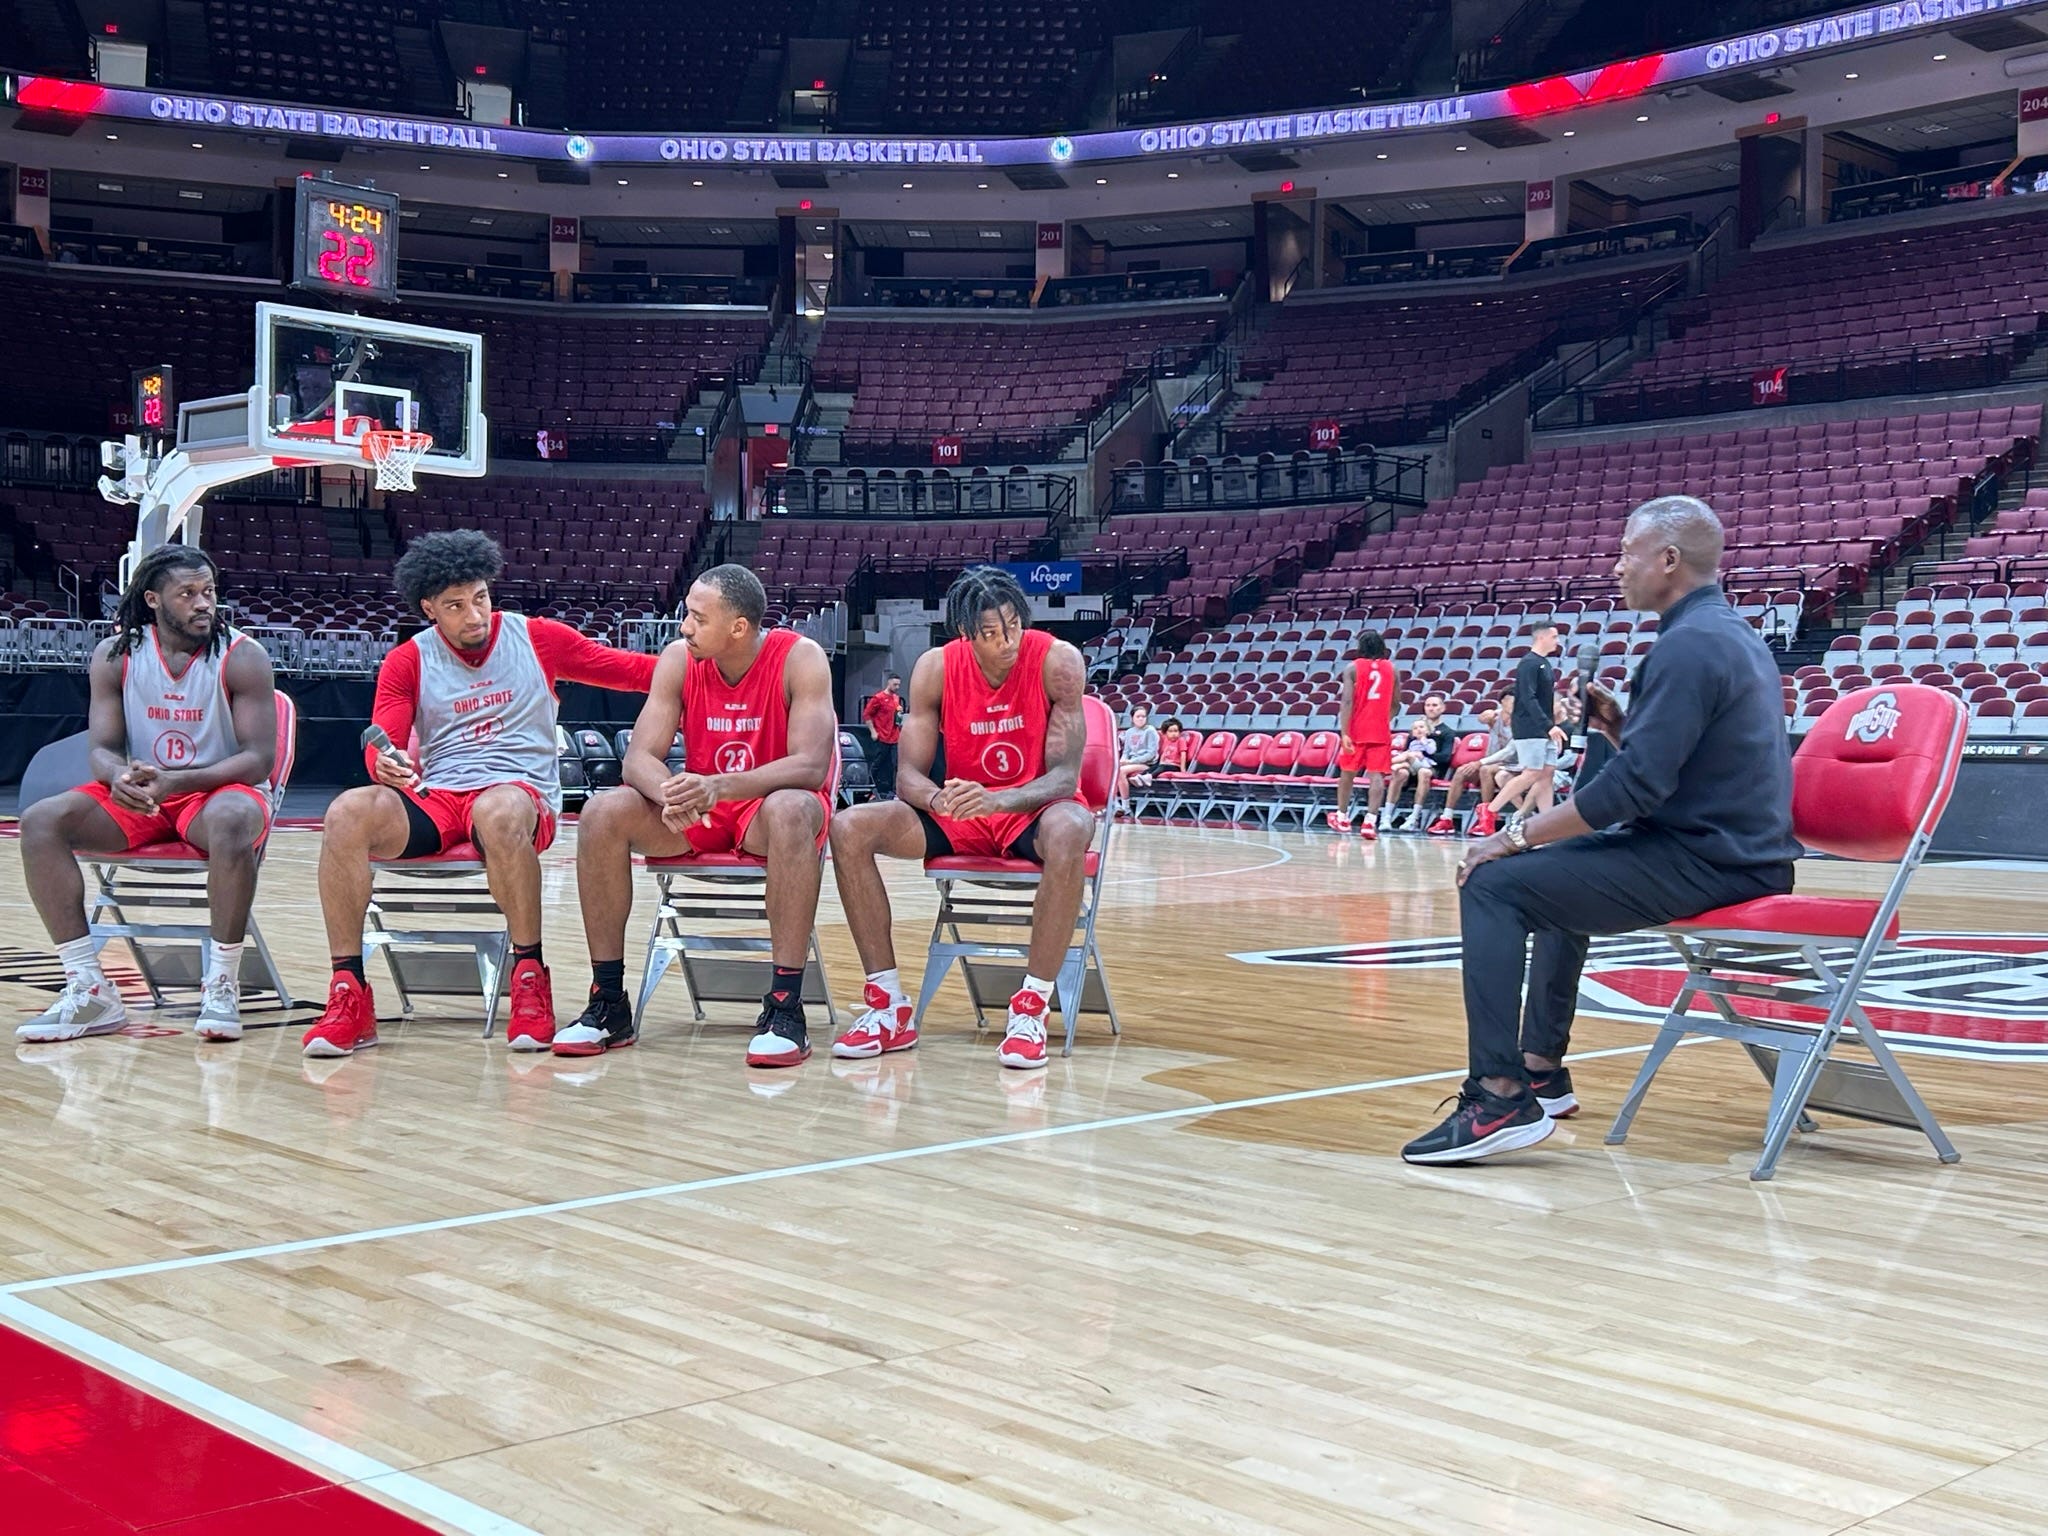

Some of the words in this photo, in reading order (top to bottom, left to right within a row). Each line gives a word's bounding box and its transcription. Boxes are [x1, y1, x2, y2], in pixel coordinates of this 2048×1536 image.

[1706, 33, 1780, 69] OHIO
[1783, 11, 1873, 52] STATE
[2023, 96, 2048, 112] 204
[150, 96, 227, 123] OHIO
[231, 104, 317, 133] STATE
[322, 112, 498, 151] BASKETBALL
[1140, 126, 1207, 152] OHIO
[1211, 117, 1291, 146] STATE
[1296, 98, 1472, 138] BASKETBALL
[659, 139, 728, 160] OHIO
[732, 140, 811, 162] STATE
[816, 141, 984, 163] BASKETBALL
[22, 175, 45, 188] 232
[1530, 189, 1551, 203] 203
[329, 202, 382, 235] 4:24
[554, 225, 575, 236] 234
[1041, 231, 1061, 241] 201
[319, 230, 374, 286] 22
[1758, 379, 1784, 394] 104
[1316, 428, 1335, 441] 101
[546, 439, 564, 451] 34
[938, 445, 958, 458] 101
[1030, 564, 1072, 590] Kroger
[1367, 670, 1381, 699] 2
[453, 697, 480, 714] OHIO
[483, 689, 514, 708] STATE
[147, 706, 170, 720] OHIO
[174, 709, 204, 721] STATE
[706, 717, 732, 731] OHIO
[970, 721, 996, 735] OHIO
[998, 715, 1024, 733] STATE
[166, 738, 185, 760] 13
[1977, 745, 2022, 755] POWER
[724, 749, 747, 772] 23
[996, 750, 1009, 772] 3
